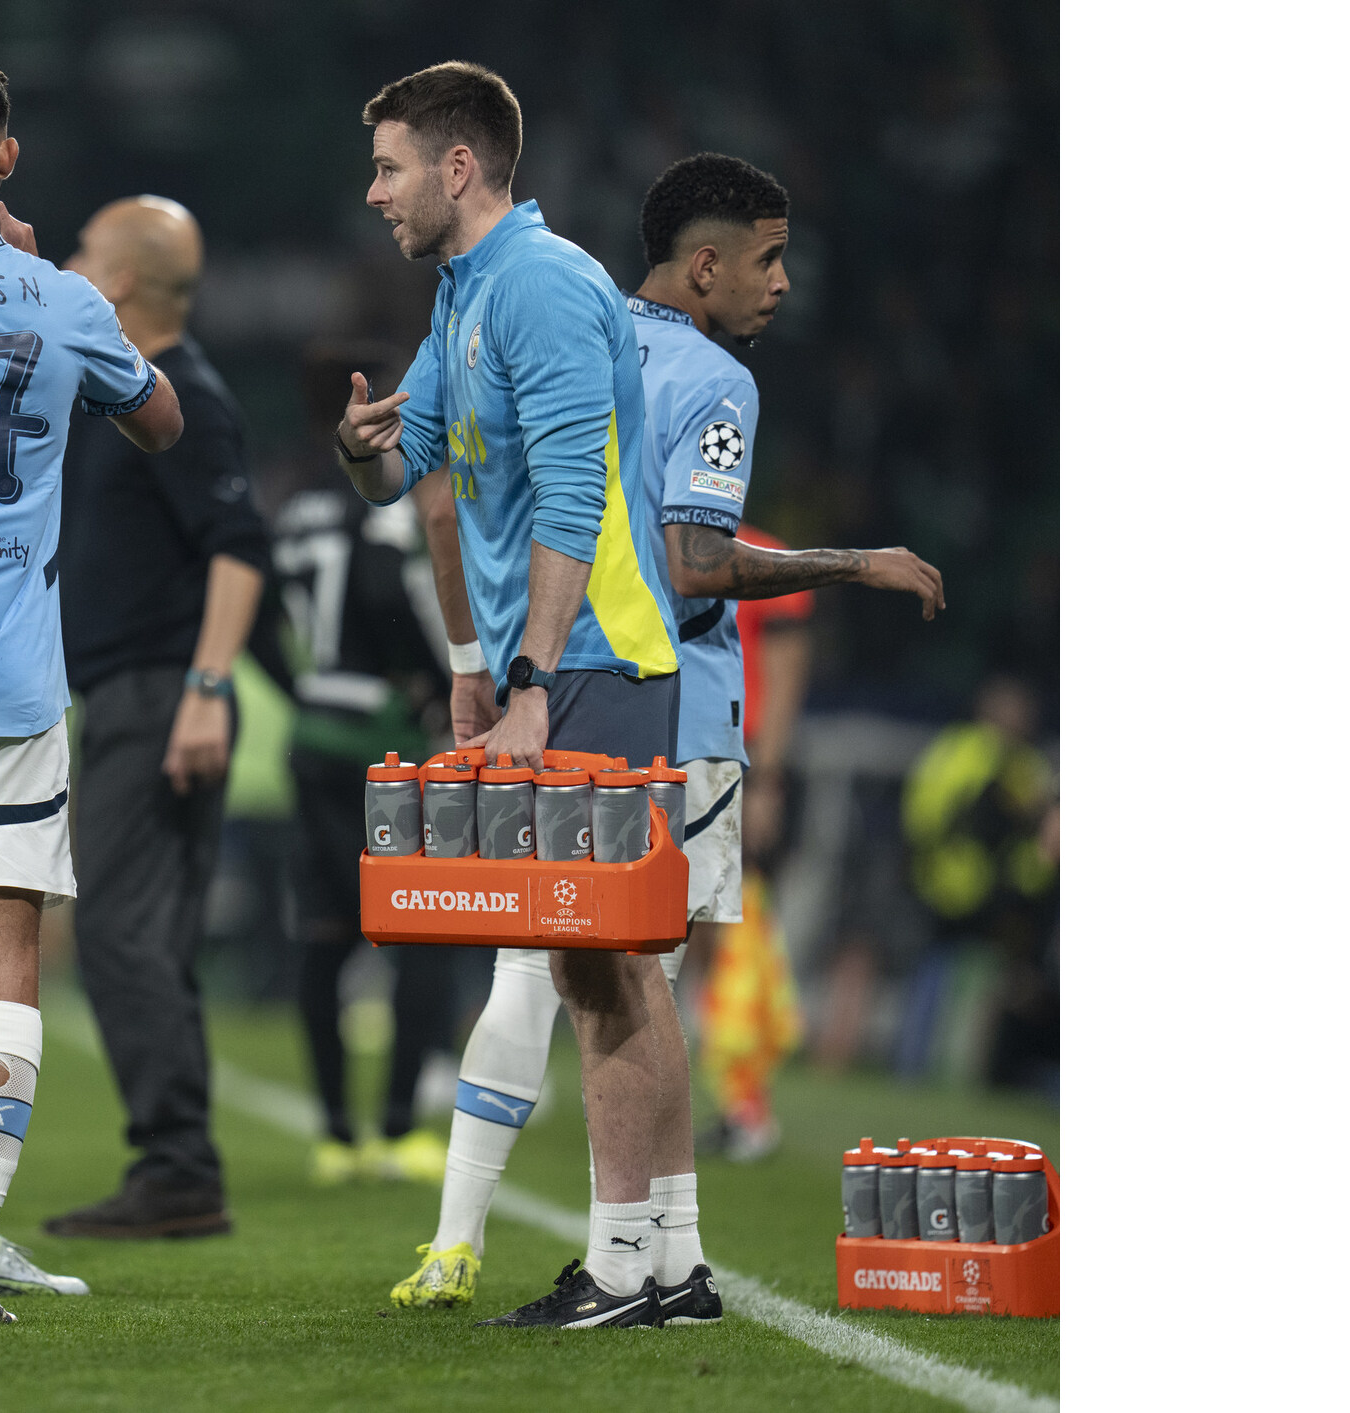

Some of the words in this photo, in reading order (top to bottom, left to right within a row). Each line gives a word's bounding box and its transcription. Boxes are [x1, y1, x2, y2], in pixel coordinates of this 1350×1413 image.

[18, 276, 47, 307] N.
[374, 824, 391, 846] G
[576, 826, 590, 848] G
[391, 889, 519, 912] GATORADE
[540, 917, 592, 926] CHAMPIONS
[930, 1209, 949, 1230] G
[854, 1269, 942, 1291] GATORADE
